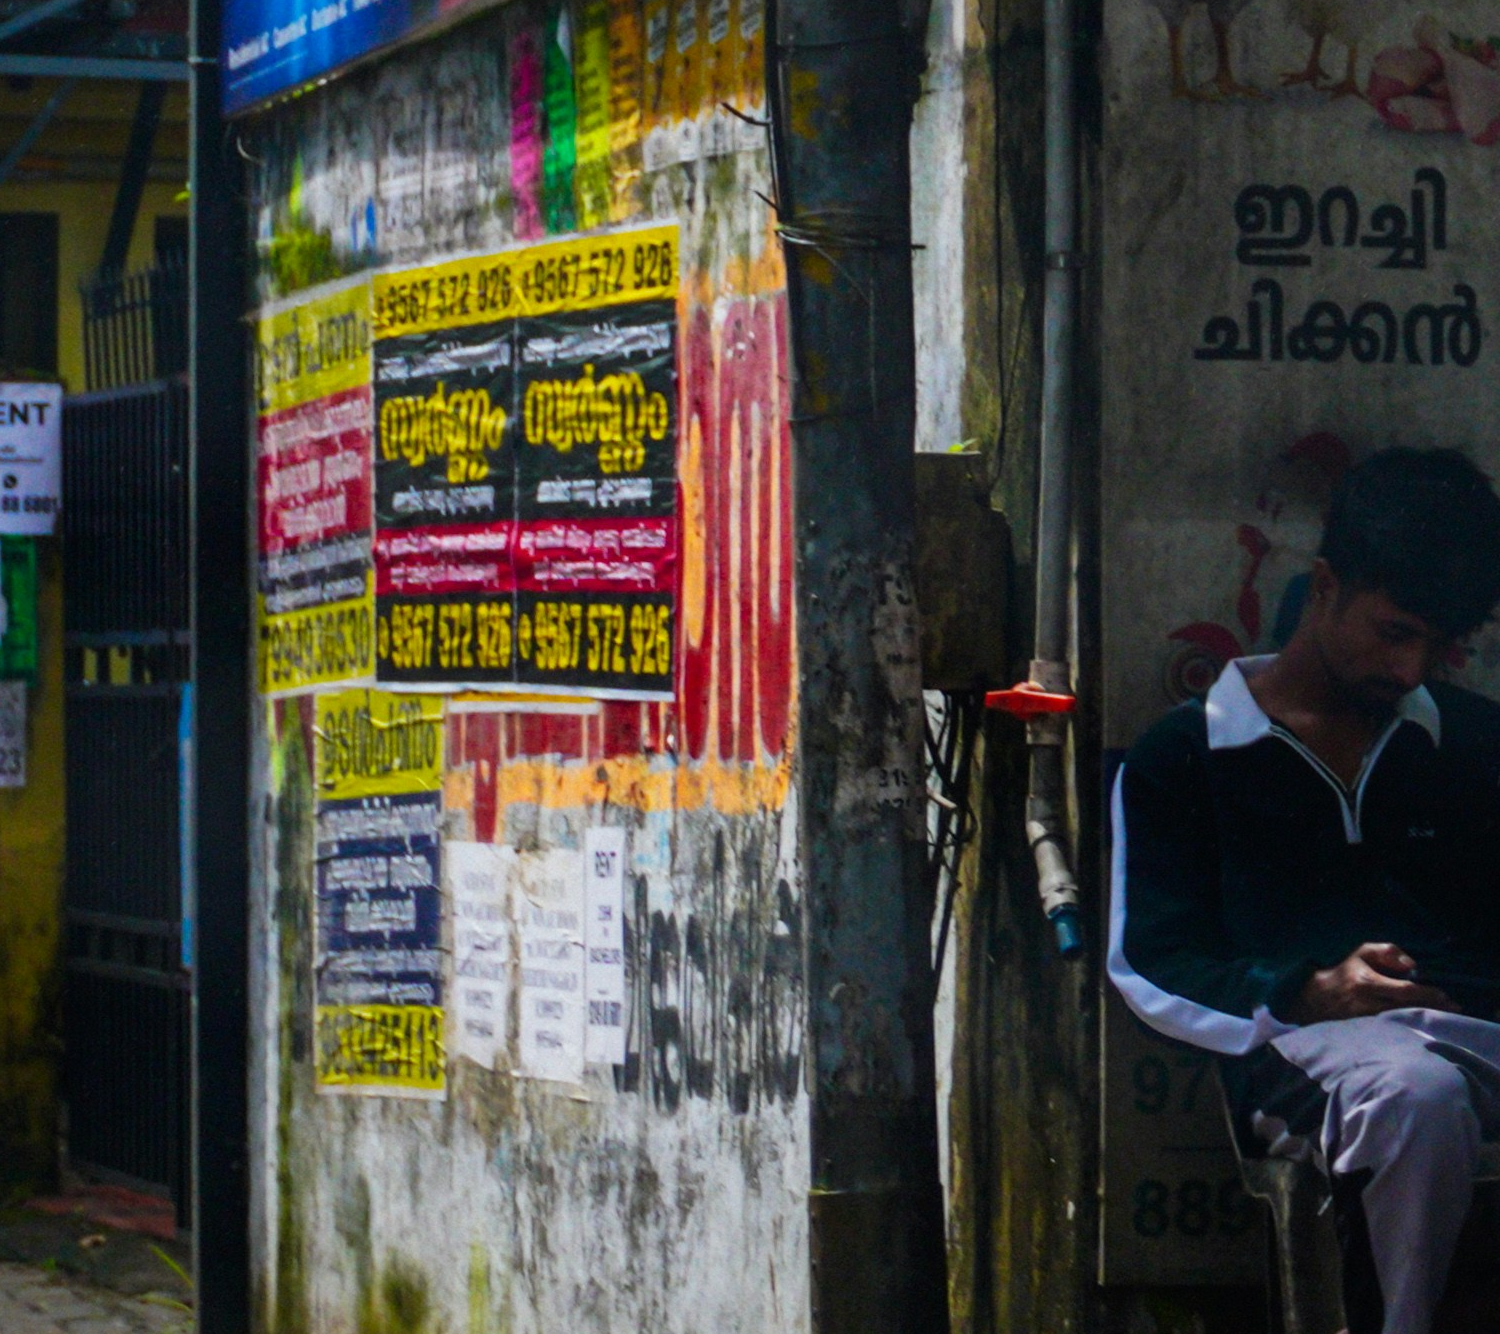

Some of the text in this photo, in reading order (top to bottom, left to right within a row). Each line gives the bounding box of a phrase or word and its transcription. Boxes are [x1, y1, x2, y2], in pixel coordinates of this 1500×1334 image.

[1233, 166, 1448, 269] ഇറച്ചി
[387, 265, 512, 327] 9567 572 926
[532, 240, 673, 303] 9567 572 926
[1193, 277, 1482, 367] ചിക്കൻ
[390, 602, 512, 668] 9567 572 926
[534, 602, 670, 675] 9567 572 926
